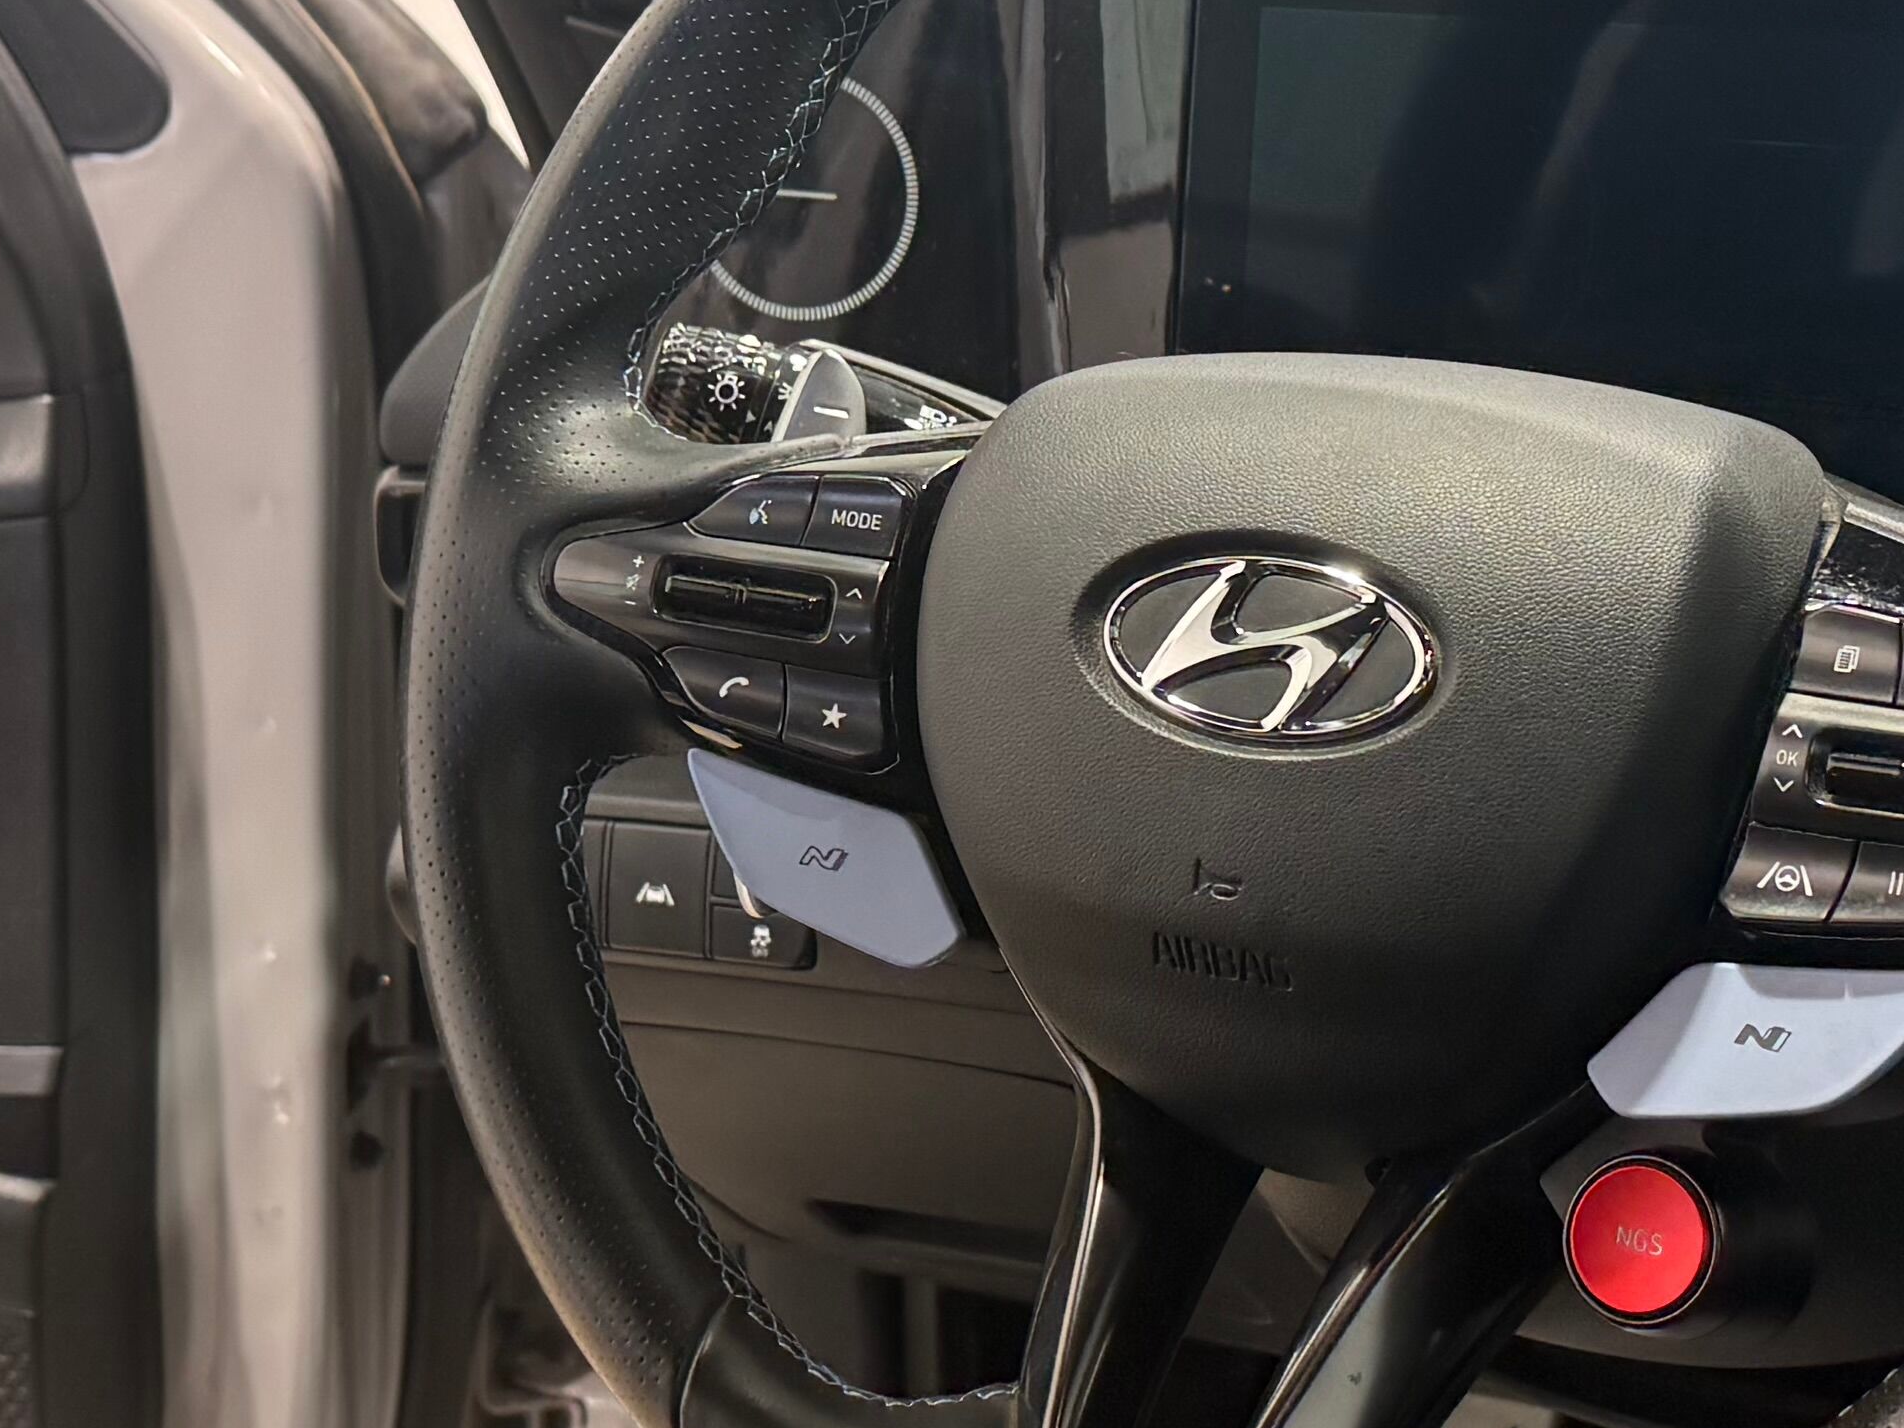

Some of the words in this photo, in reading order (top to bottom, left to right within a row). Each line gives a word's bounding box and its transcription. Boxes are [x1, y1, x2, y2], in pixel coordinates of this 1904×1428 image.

[831, 507, 883, 531] MODE
[1776, 750, 1799, 766] OK
[1616, 1226, 1663, 1256] NGS
